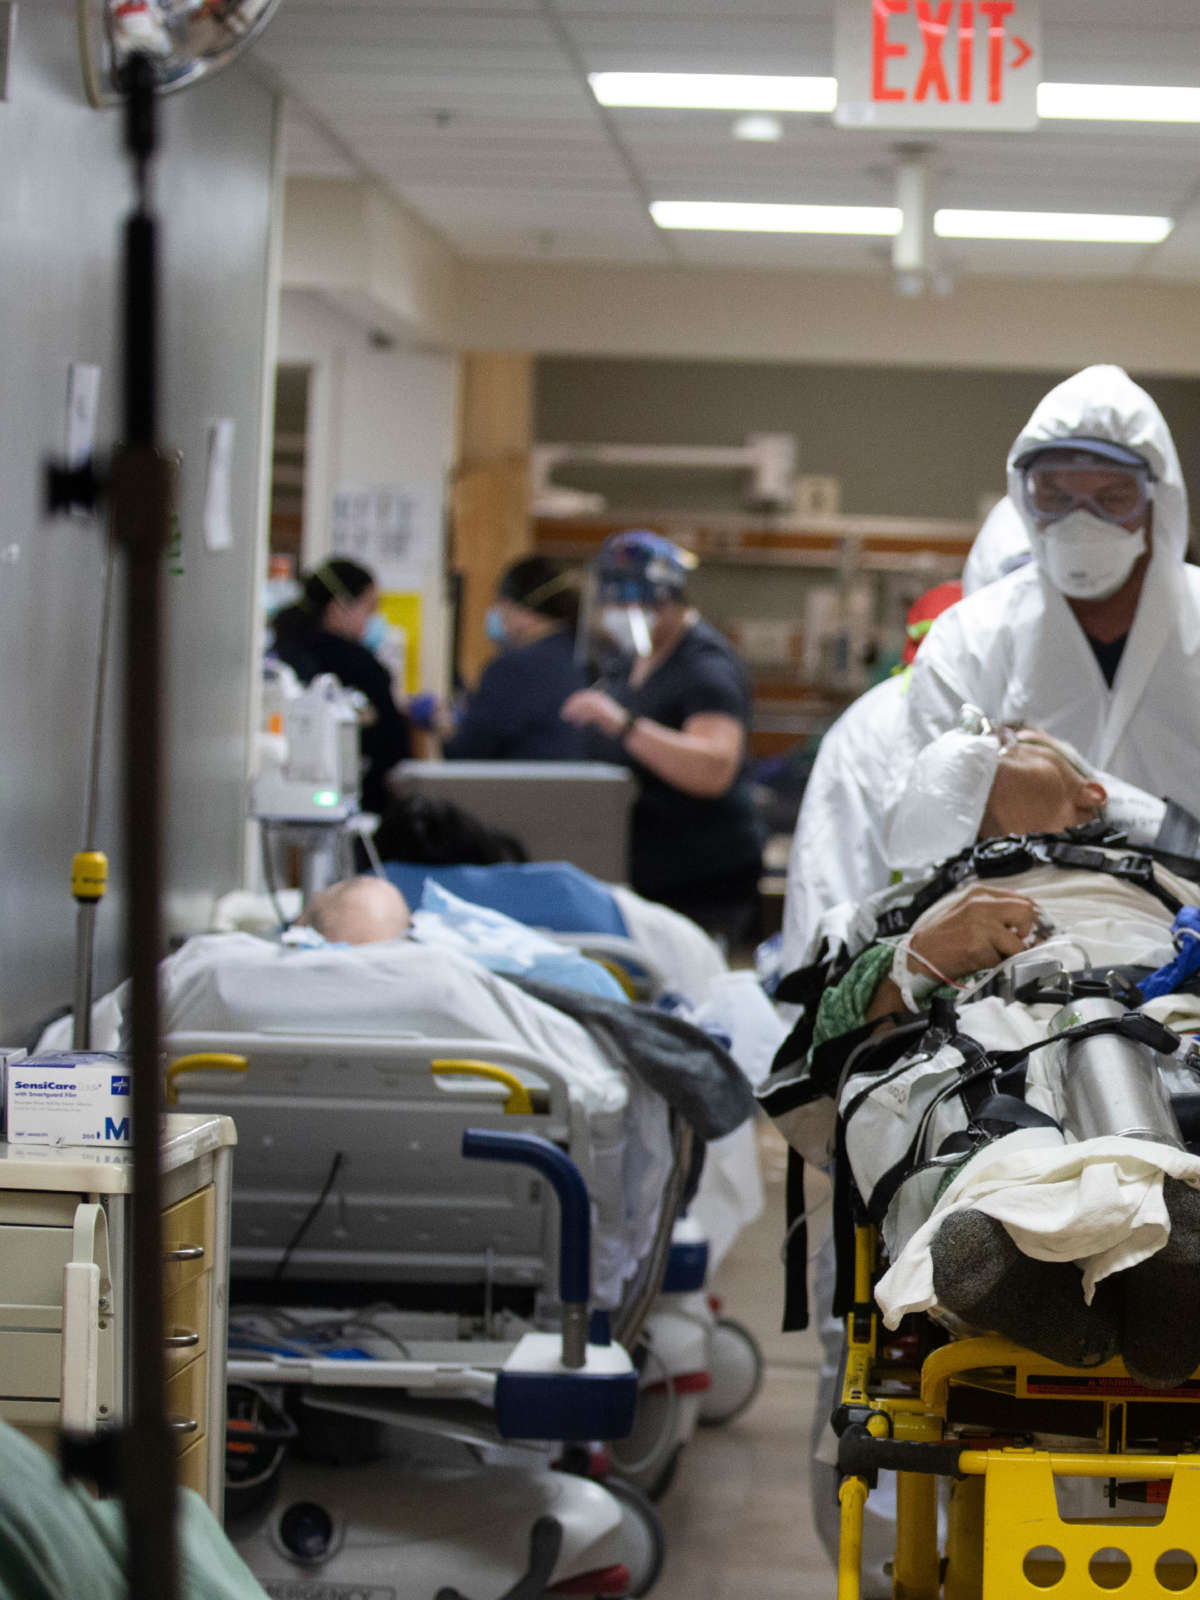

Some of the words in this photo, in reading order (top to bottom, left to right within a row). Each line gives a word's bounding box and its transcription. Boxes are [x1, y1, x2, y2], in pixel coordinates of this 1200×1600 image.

[872, 0, 1015, 103] EXIT
[14, 1081, 77, 1091] SensiCare
[105, 1117, 130, 1141] M
